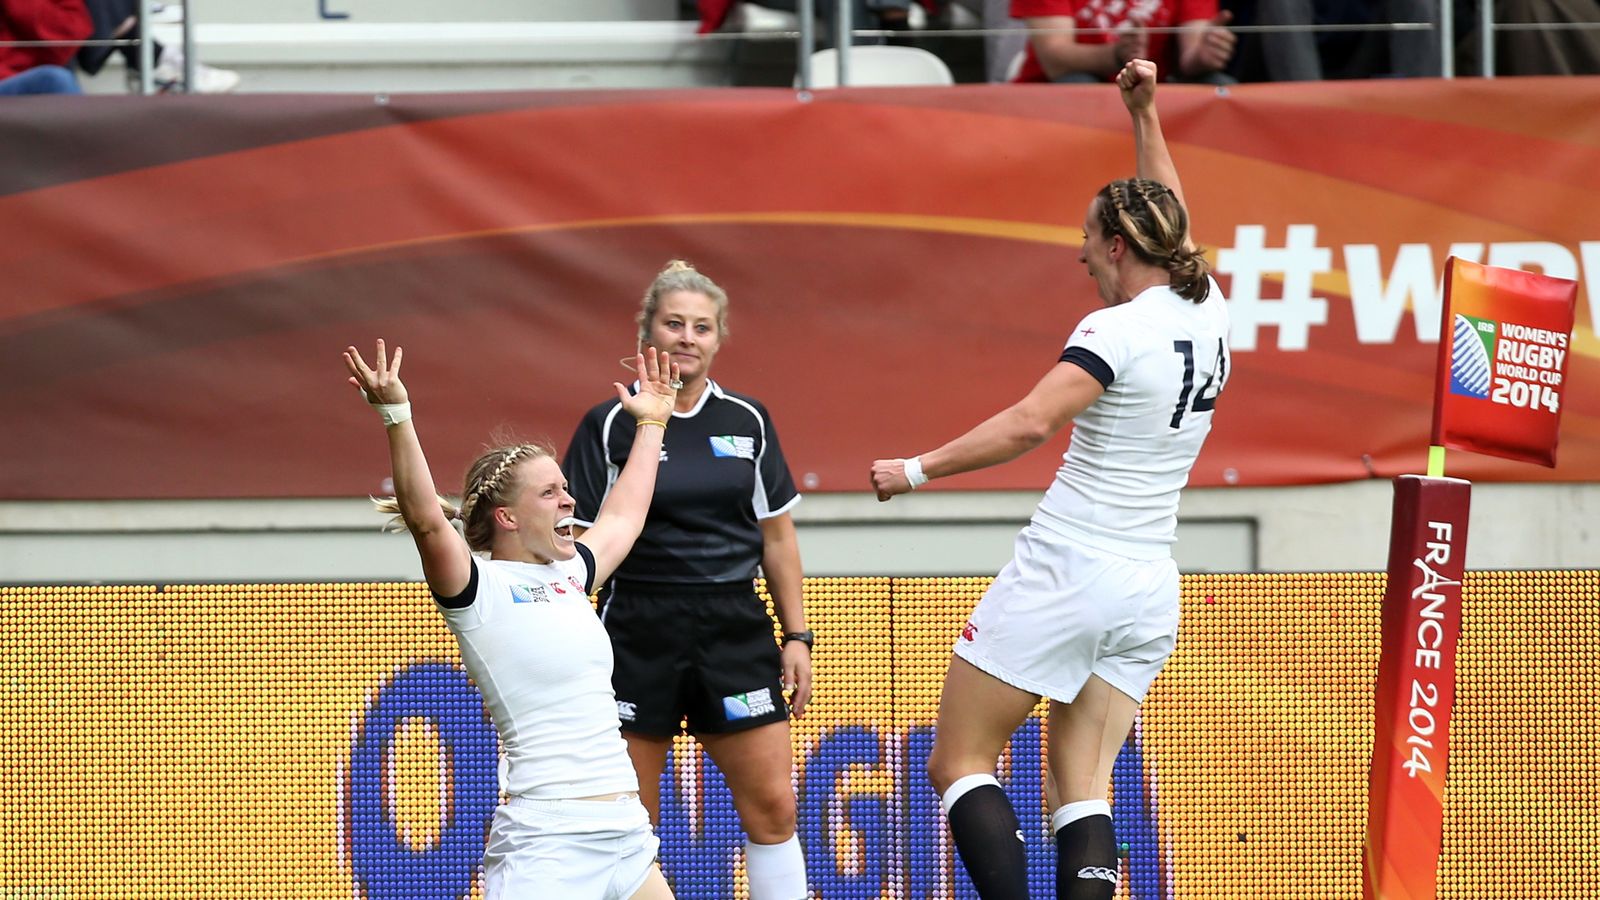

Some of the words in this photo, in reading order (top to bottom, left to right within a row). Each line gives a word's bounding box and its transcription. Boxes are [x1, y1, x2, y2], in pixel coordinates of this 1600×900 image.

[1501, 322, 1567, 347] WOMEN'S
[1496, 361, 1538, 381] WORLD
[1539, 369, 1562, 385] CUP
[1497, 338, 1566, 371] RUGBY
[1169, 337, 1226, 429] 14
[1491, 377, 1560, 414] 2014
[1411, 521, 1462, 669] FRANCE
[1402, 679, 1438, 778] 2014
